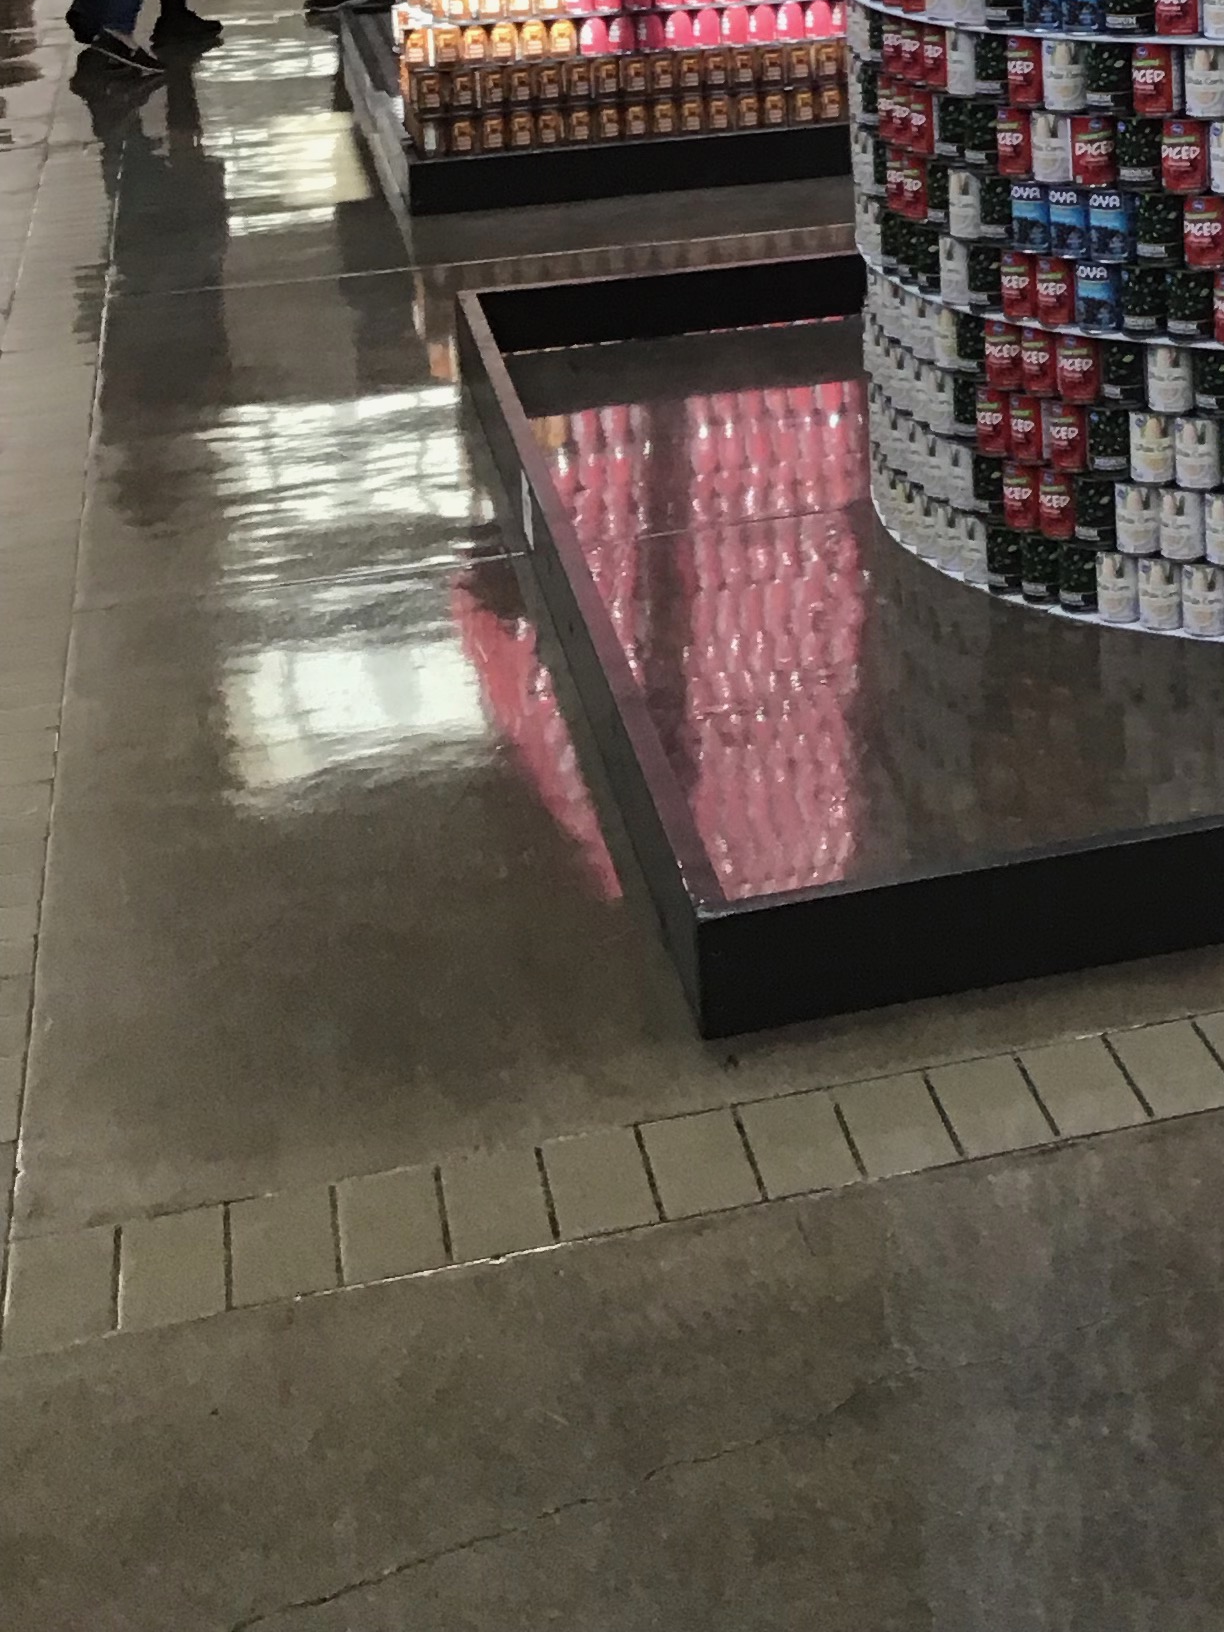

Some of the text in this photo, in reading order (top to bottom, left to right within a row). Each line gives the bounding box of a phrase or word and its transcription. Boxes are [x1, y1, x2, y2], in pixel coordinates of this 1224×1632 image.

[1075, 142, 1115, 155] DICED
[1161, 145, 1200, 159] DICED
[1184, 221, 1221, 236] DICED
[985, 343, 1021, 357] DICED
